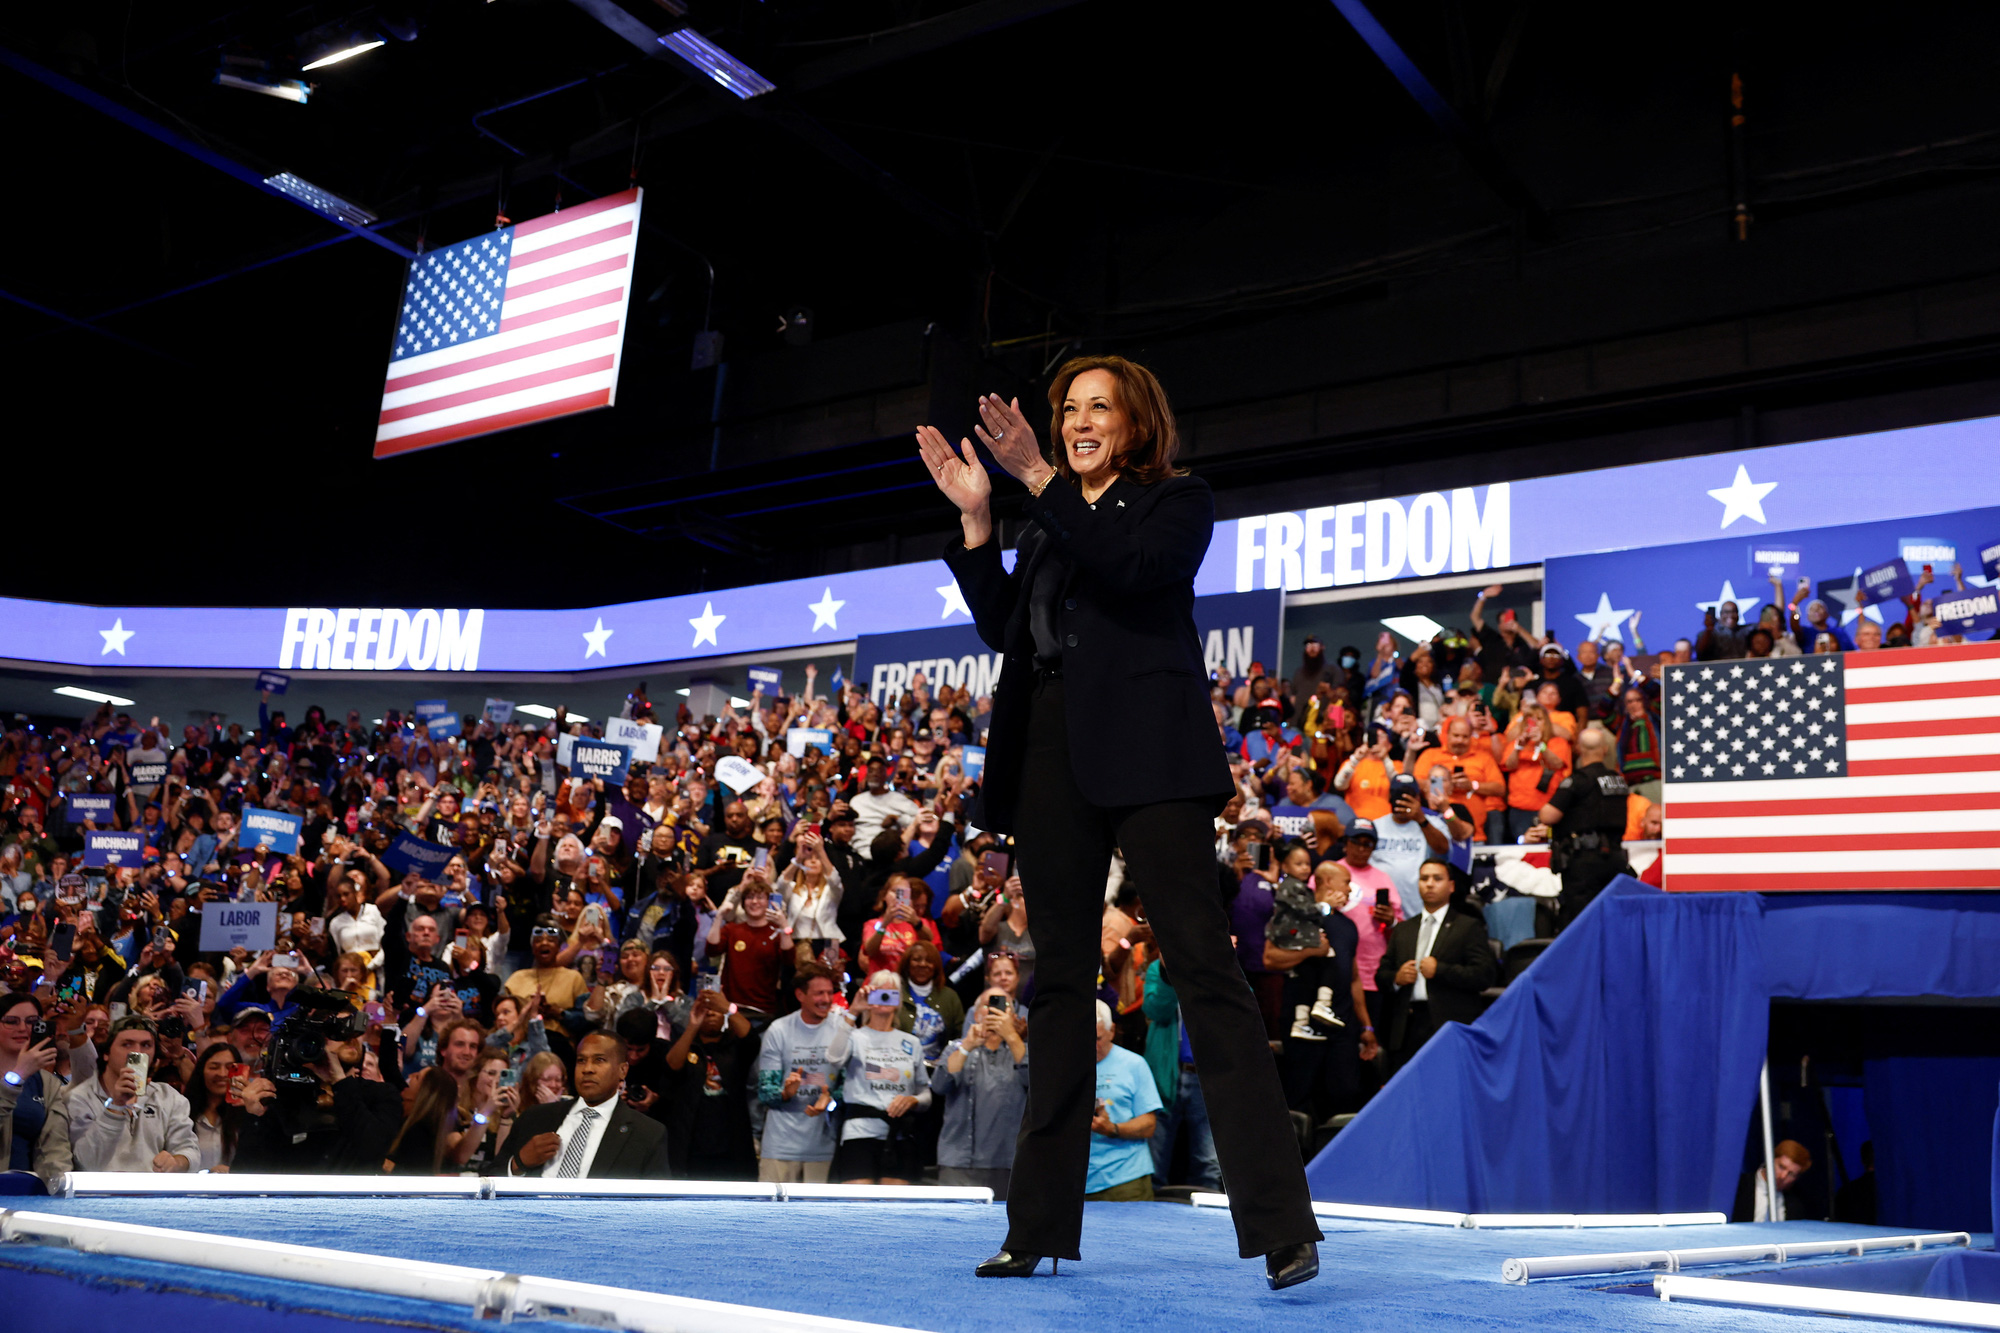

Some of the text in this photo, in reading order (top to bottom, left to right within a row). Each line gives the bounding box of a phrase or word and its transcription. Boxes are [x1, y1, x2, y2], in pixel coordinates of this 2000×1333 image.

[1236, 482, 1510, 593] FREEDOM
[1903, 546, 1956, 561] FREEDOM
[1935, 594, 1997, 622] FREEDOM
[279, 608, 484, 671] FREEDOM
[1198, 626, 1254, 680] AN
[871, 653, 1004, 706] FREEDOM
[618, 725, 649, 741] LABOR
[577, 747, 622, 767] HARRIS
[583, 764, 613, 776] WALZ
[72, 798, 111, 809] MICHIGAN
[247, 815, 296, 835] MICHIGAN
[1273, 816, 1308, 836] FREE
[91, 836, 139, 851] MICHIGAN
[220, 910, 260, 926] LABOR
[791, 1058, 829, 1066] AMERICA
